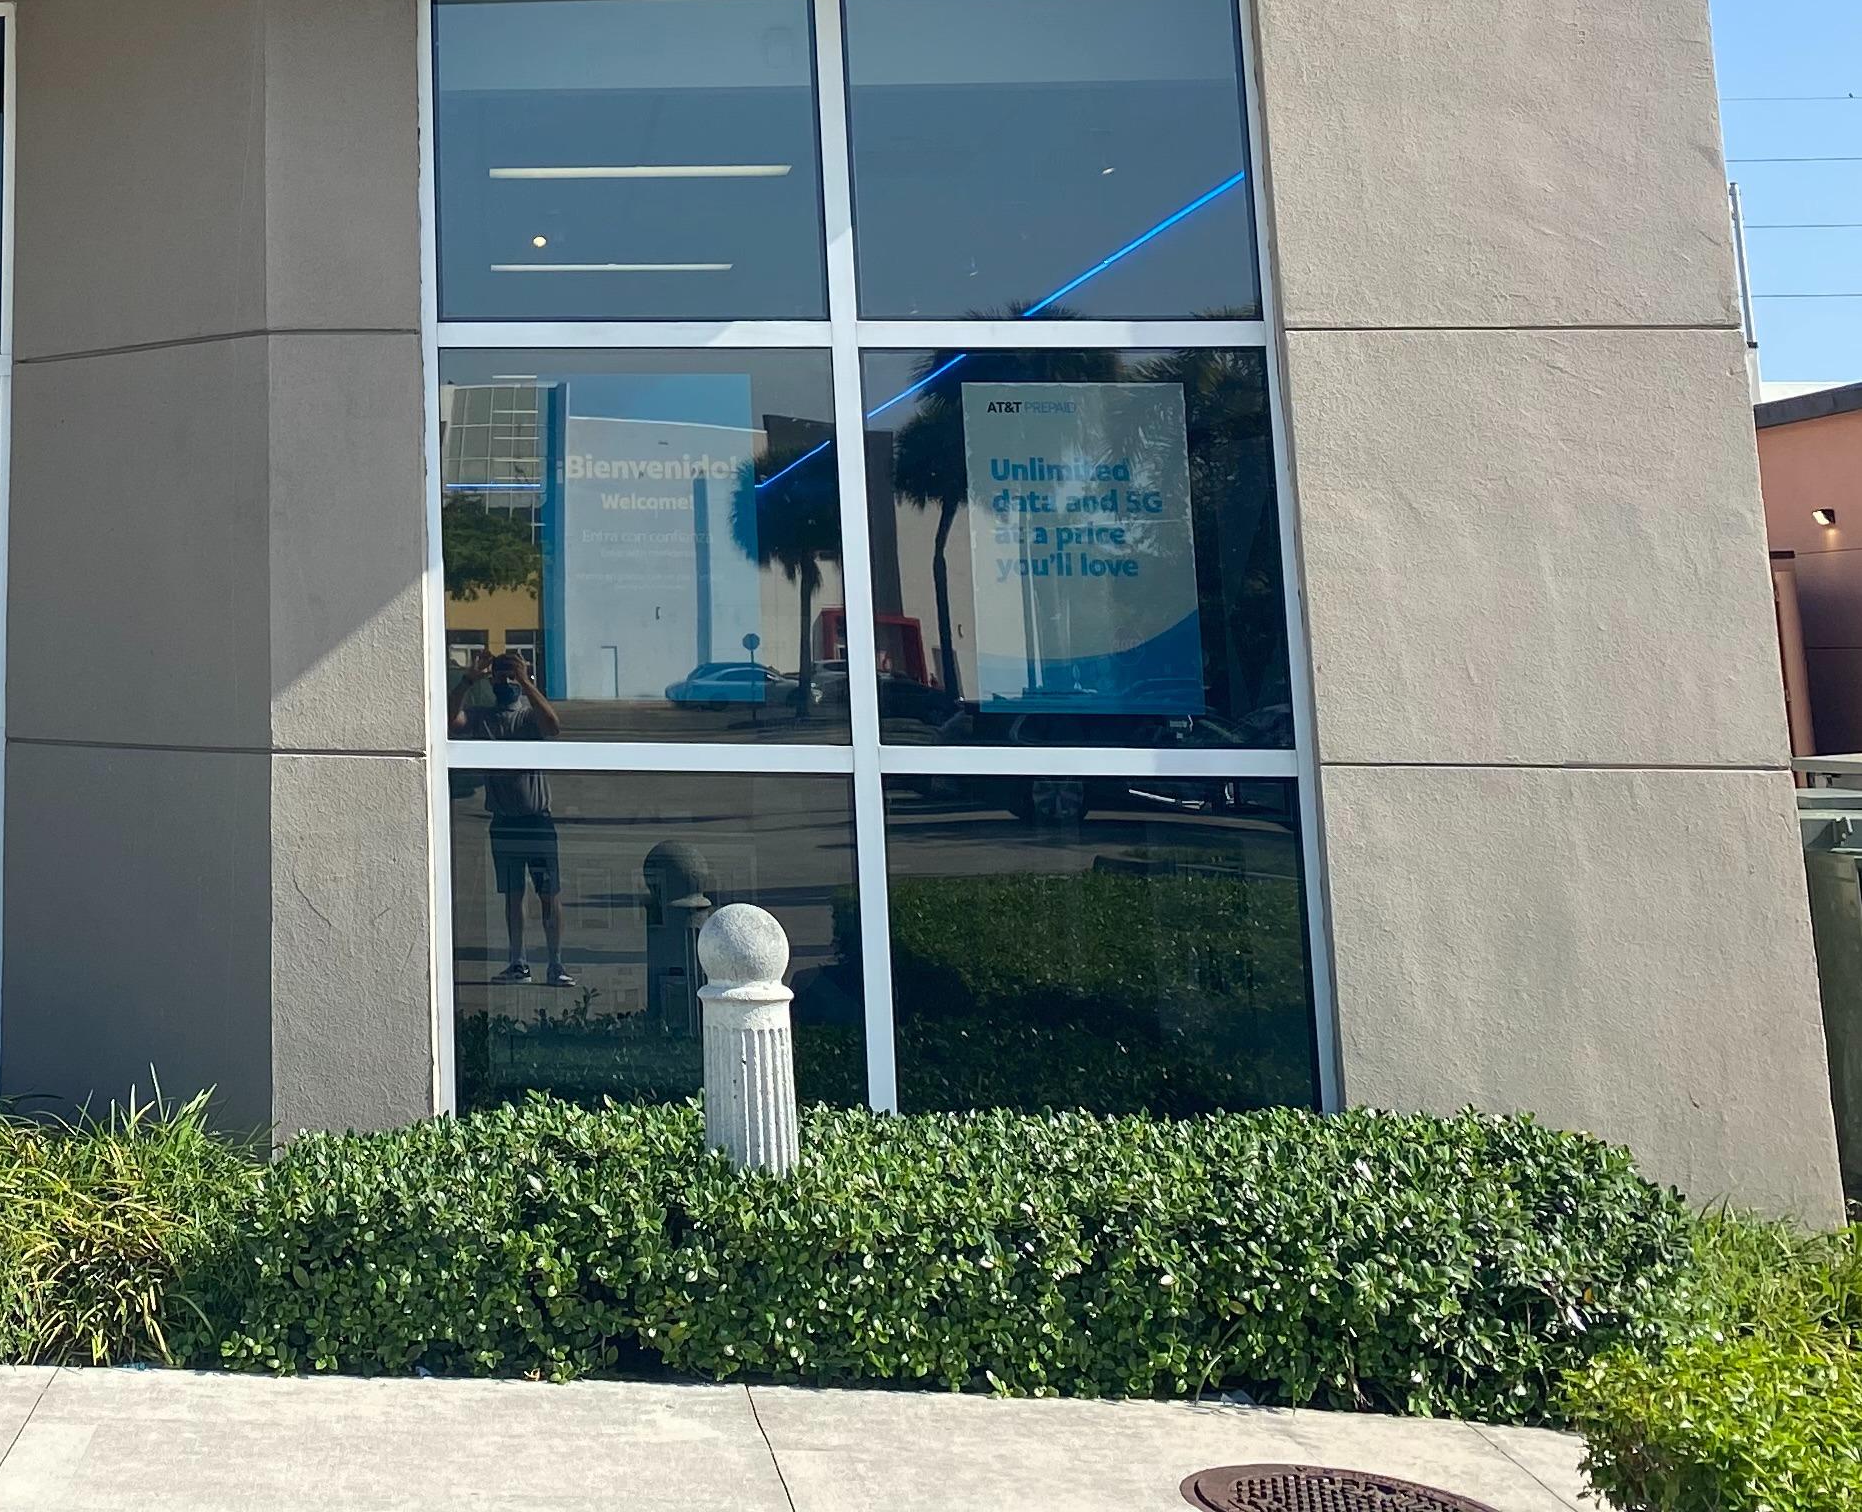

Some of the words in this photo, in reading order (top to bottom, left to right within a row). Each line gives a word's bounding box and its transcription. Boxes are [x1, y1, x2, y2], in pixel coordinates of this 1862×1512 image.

[988, 402, 1022, 413] AT&T
[1024, 402, 1077, 413] PREPAID
[1066, 489, 1118, 514] and
[1125, 490, 1163, 514] 5G
[1034, 526, 1048, 545] a
[1056, 522, 1125, 551] price
[1081, 553, 1139, 577] love
